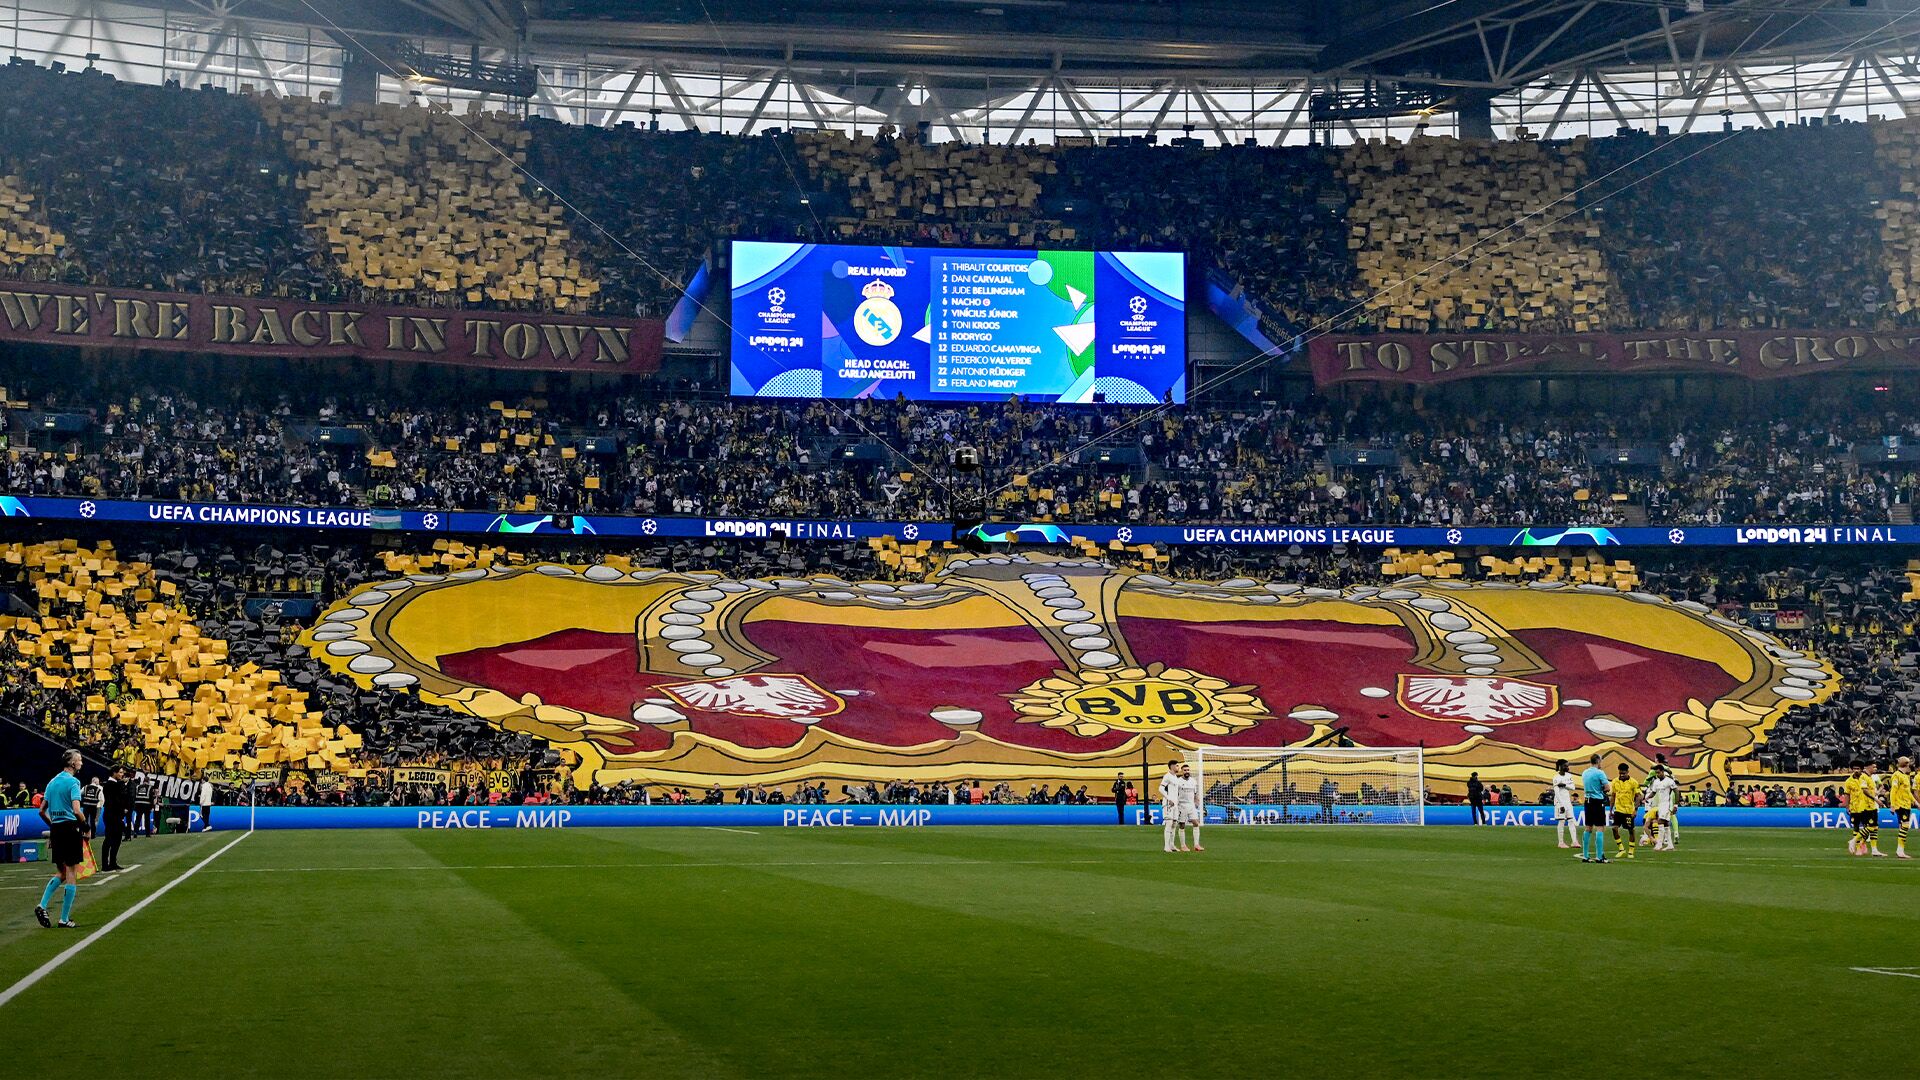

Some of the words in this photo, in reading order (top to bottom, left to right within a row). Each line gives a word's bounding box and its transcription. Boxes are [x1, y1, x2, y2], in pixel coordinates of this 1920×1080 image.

[848, 267, 869, 276] REAL
[871, 267, 906, 277] MADRID
[987, 264, 1028, 272] COURTOIS
[972, 287, 1025, 295] BELLINGHAM
[951, 308, 986, 317] VINÍCIUS
[988, 308, 1018, 318] JÚNIOR
[0, 292, 189, 340] WE'RE
[211, 304, 365, 349] BACK
[386, 316, 449, 353] IN
[465, 320, 632, 362] TOWN
[952, 333, 992, 341] RODRYGO
[1338, 342, 1411, 372] TO
[1624, 338, 1738, 366] THE
[845, 360, 871, 368] HEAD
[874, 360, 910, 369] COACH:
[839, 370, 867, 378] CARLO
[869, 371, 916, 379] ANCELOTTI
[149, 504, 194, 521] UEFA
[199, 507, 302, 524] CHAMPIONS
[307, 510, 371, 526] LEAGUE
[797, 524, 855, 538] FINAL
[1184, 529, 1226, 542] UEFA
[1230, 529, 1326, 543] CHAMPIONS
[1332, 530, 1395, 544] LEAGUE
[1804, 528, 1826, 542] 24
[1834, 528, 1896, 542] FINAL
[1074, 684, 1204, 716] BVB
[1124, 715, 1166, 724] 09
[408, 772, 436, 782] LEGIO
[488, 770, 510, 788] BVB
[418, 810, 491, 828] PEACE
[516, 810, 571, 828] МИР
[783, 810, 854, 826] PEACE
[879, 809, 931, 826] МИР
[1810, 812, 1864, 828] PEA
